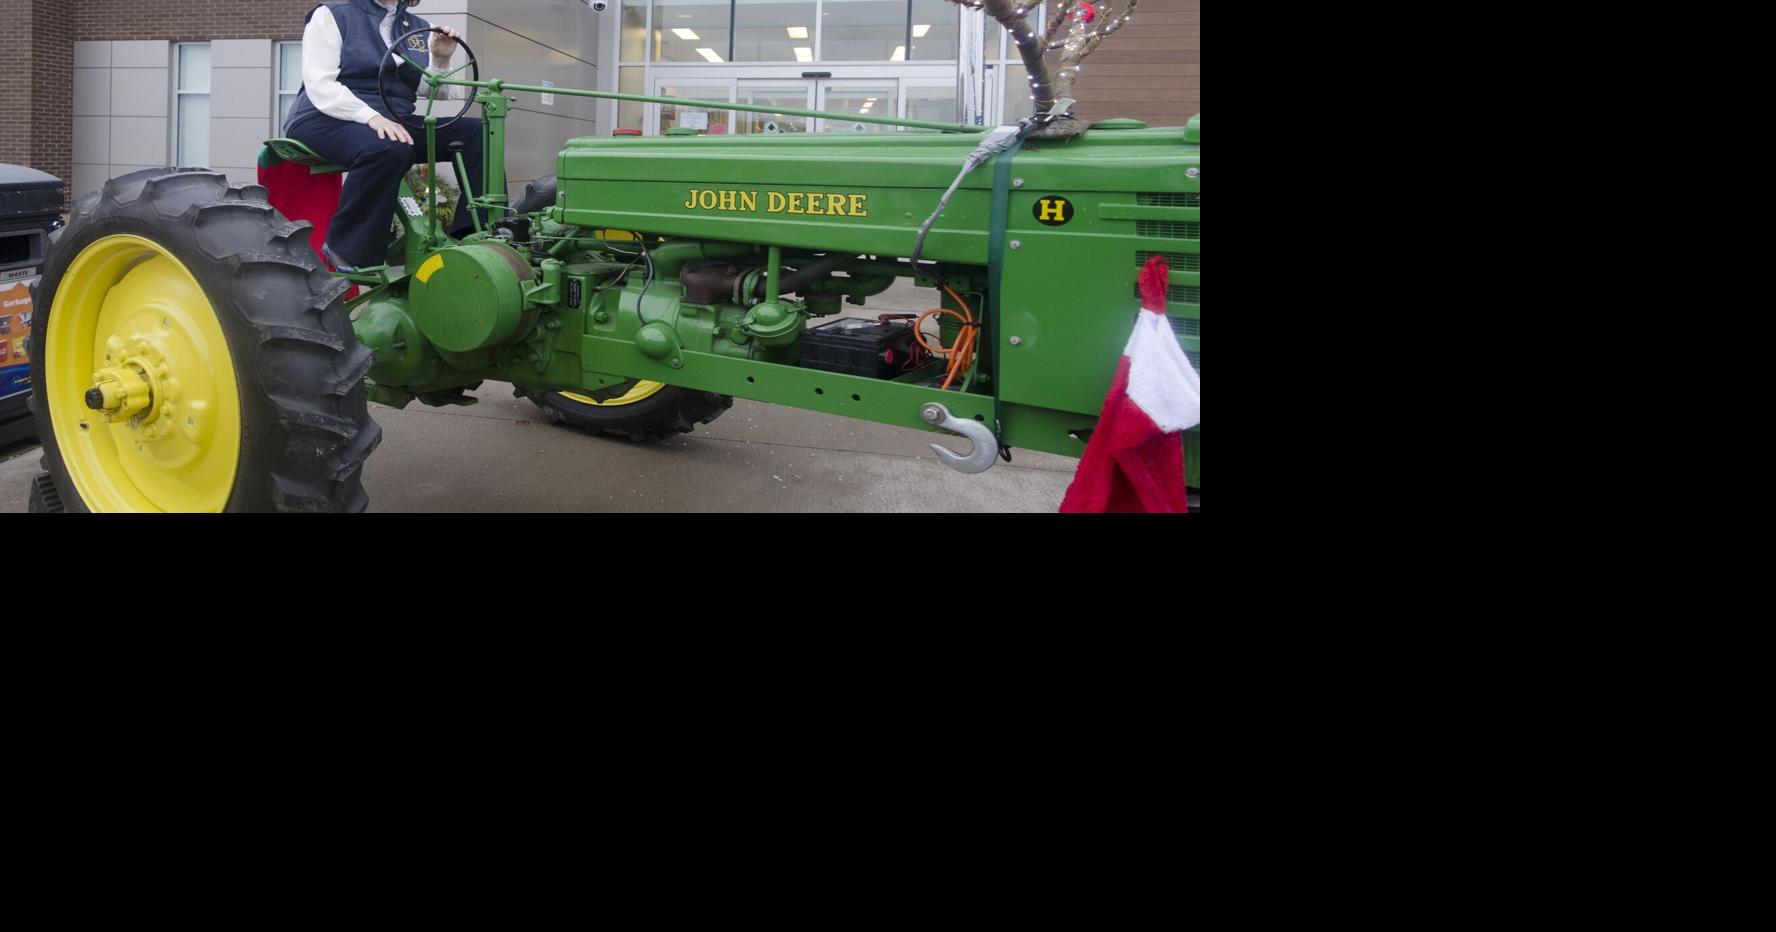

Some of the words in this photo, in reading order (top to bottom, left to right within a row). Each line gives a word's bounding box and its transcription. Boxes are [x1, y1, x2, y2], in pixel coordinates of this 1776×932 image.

[684, 188, 758, 212] JOHN
[766, 190, 868, 217] DEERE
[1039, 199, 1065, 221] H
